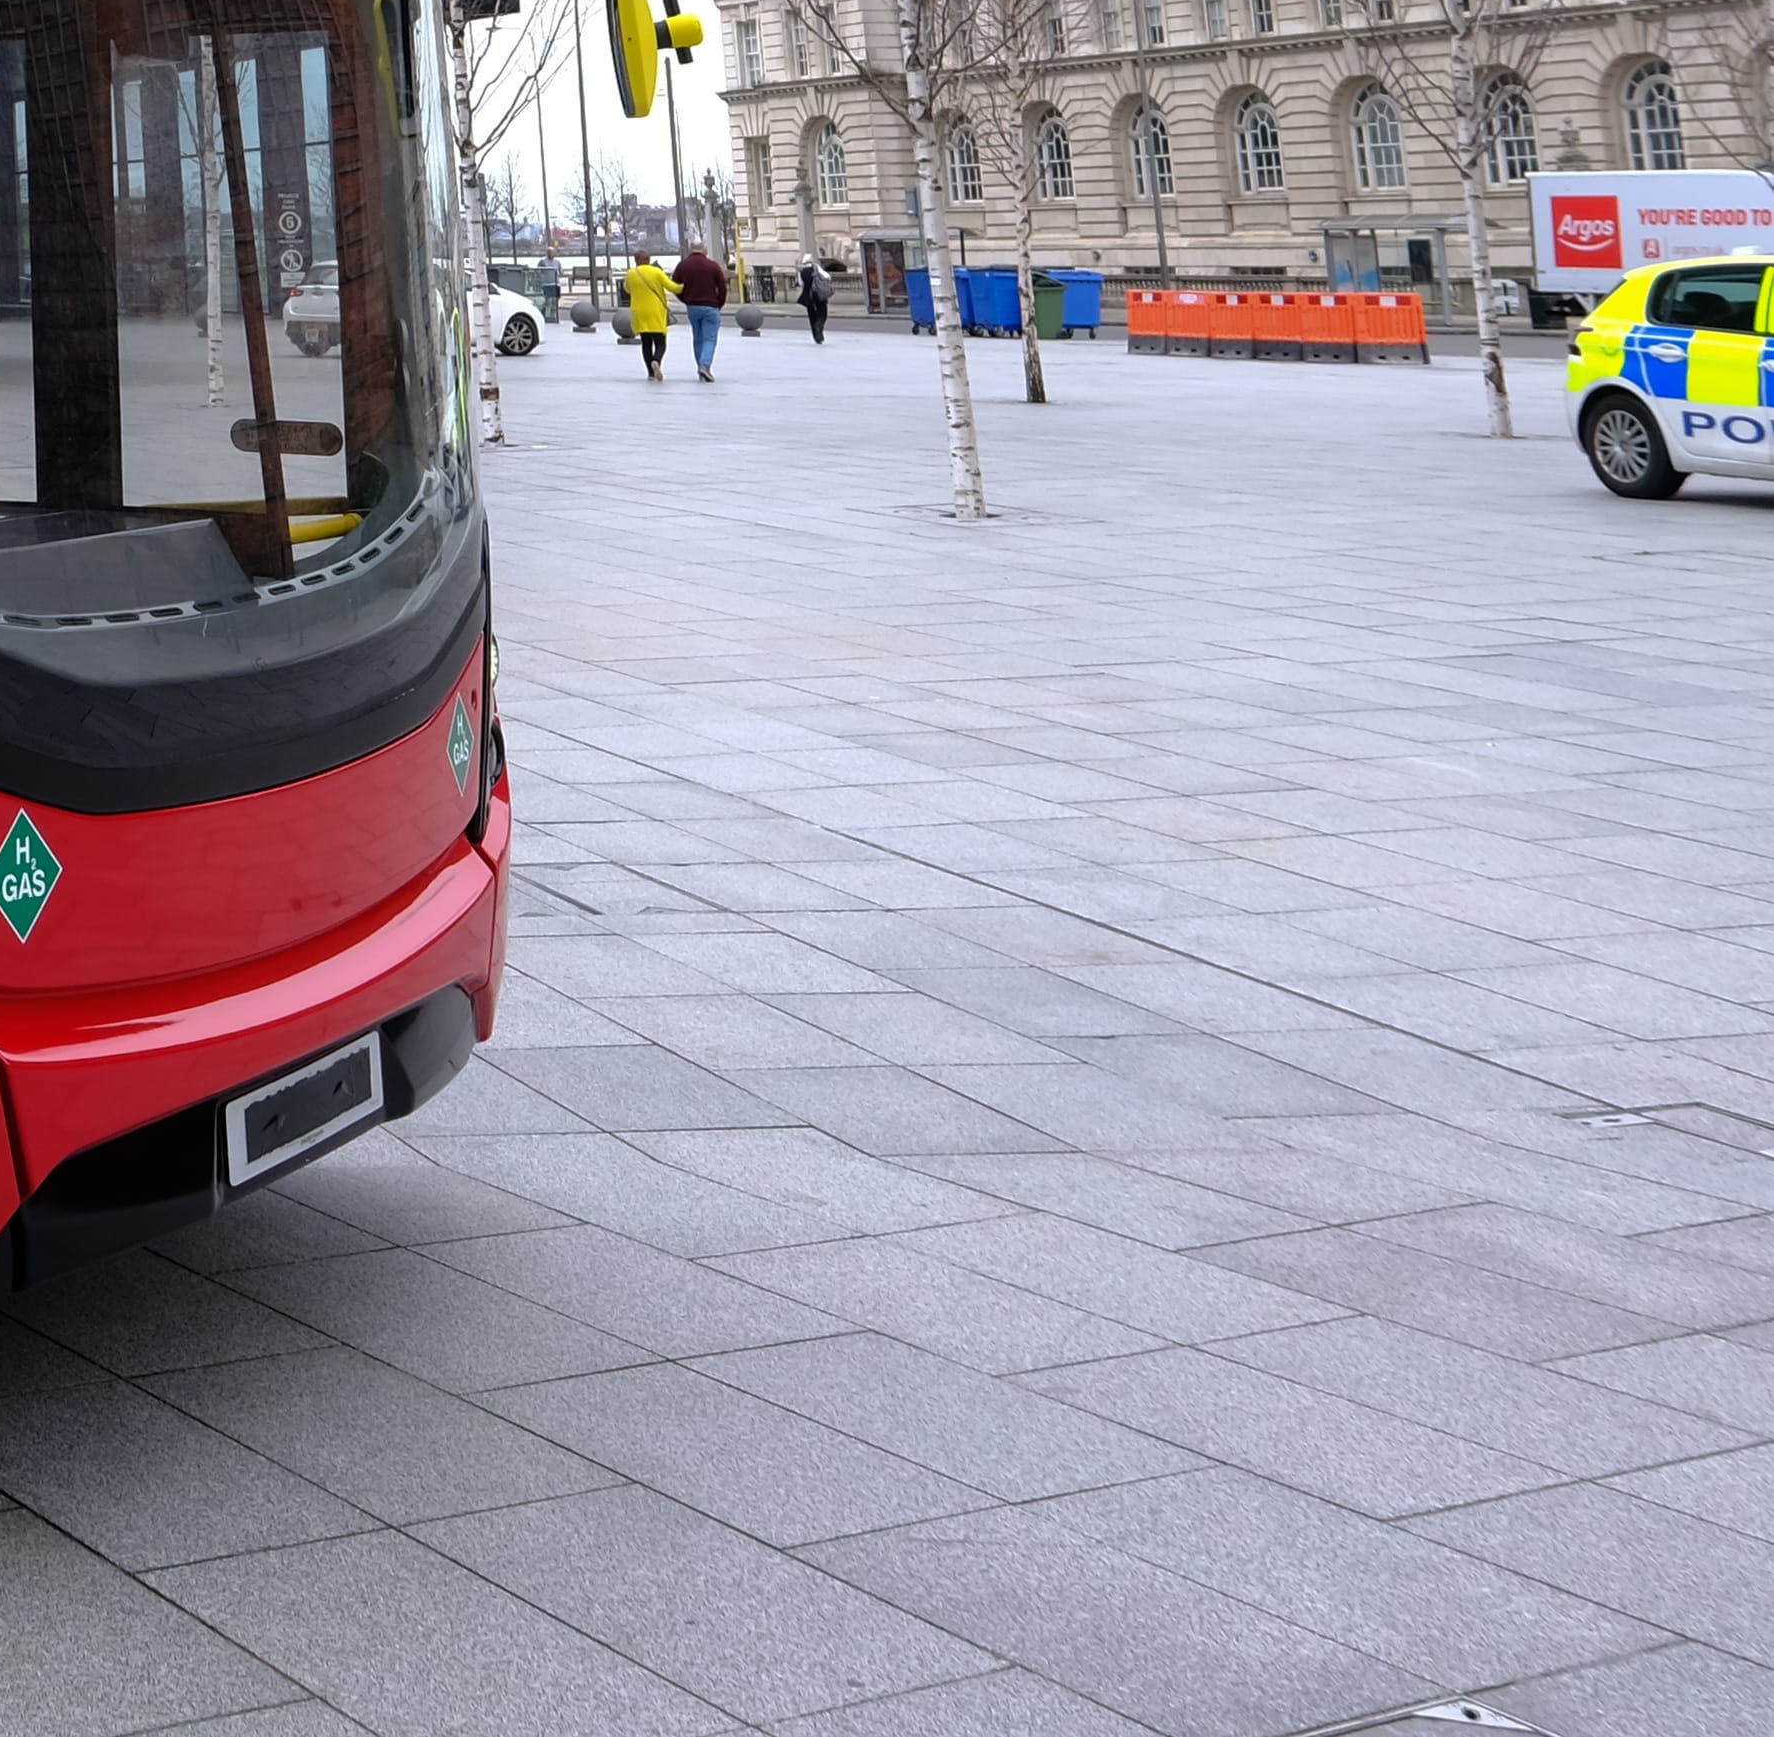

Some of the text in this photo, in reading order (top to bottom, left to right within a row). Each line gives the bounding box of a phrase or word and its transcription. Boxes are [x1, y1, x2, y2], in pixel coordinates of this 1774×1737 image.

[1557, 214, 1615, 245] Argos
[1637, 208, 1773, 226] YOU'RE GOOD TO
[1682, 410, 1774, 444] PO
[453, 739, 469, 766] GAS
[2, 869, 46, 902] GAS
